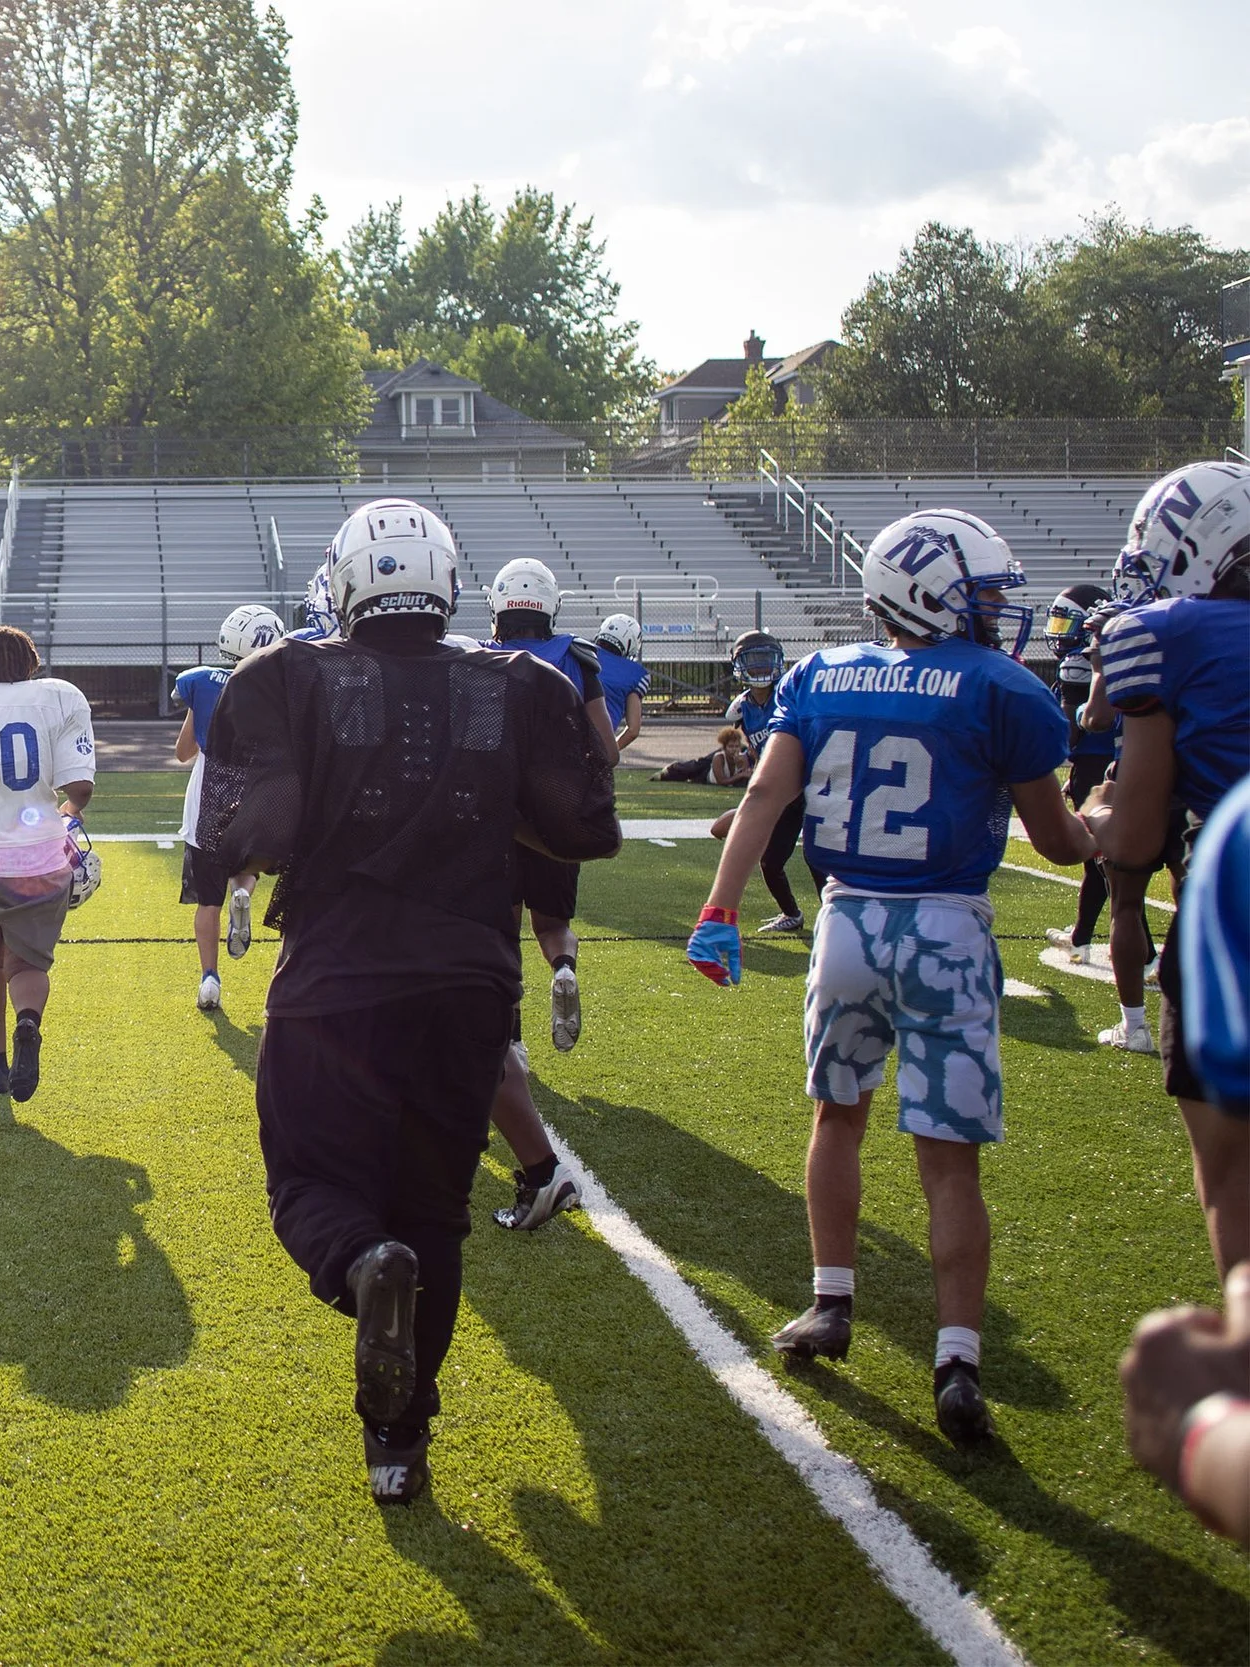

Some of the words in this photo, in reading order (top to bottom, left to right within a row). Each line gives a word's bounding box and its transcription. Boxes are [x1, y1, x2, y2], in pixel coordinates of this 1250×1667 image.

[883, 532, 946, 577] N
[380, 592, 428, 608] schutt
[507, 599, 543, 610] Riddell
[209, 671, 230, 684] PRI
[810, 665, 962, 698] PRIDERCISE.COM
[805, 730, 933, 860] 42
